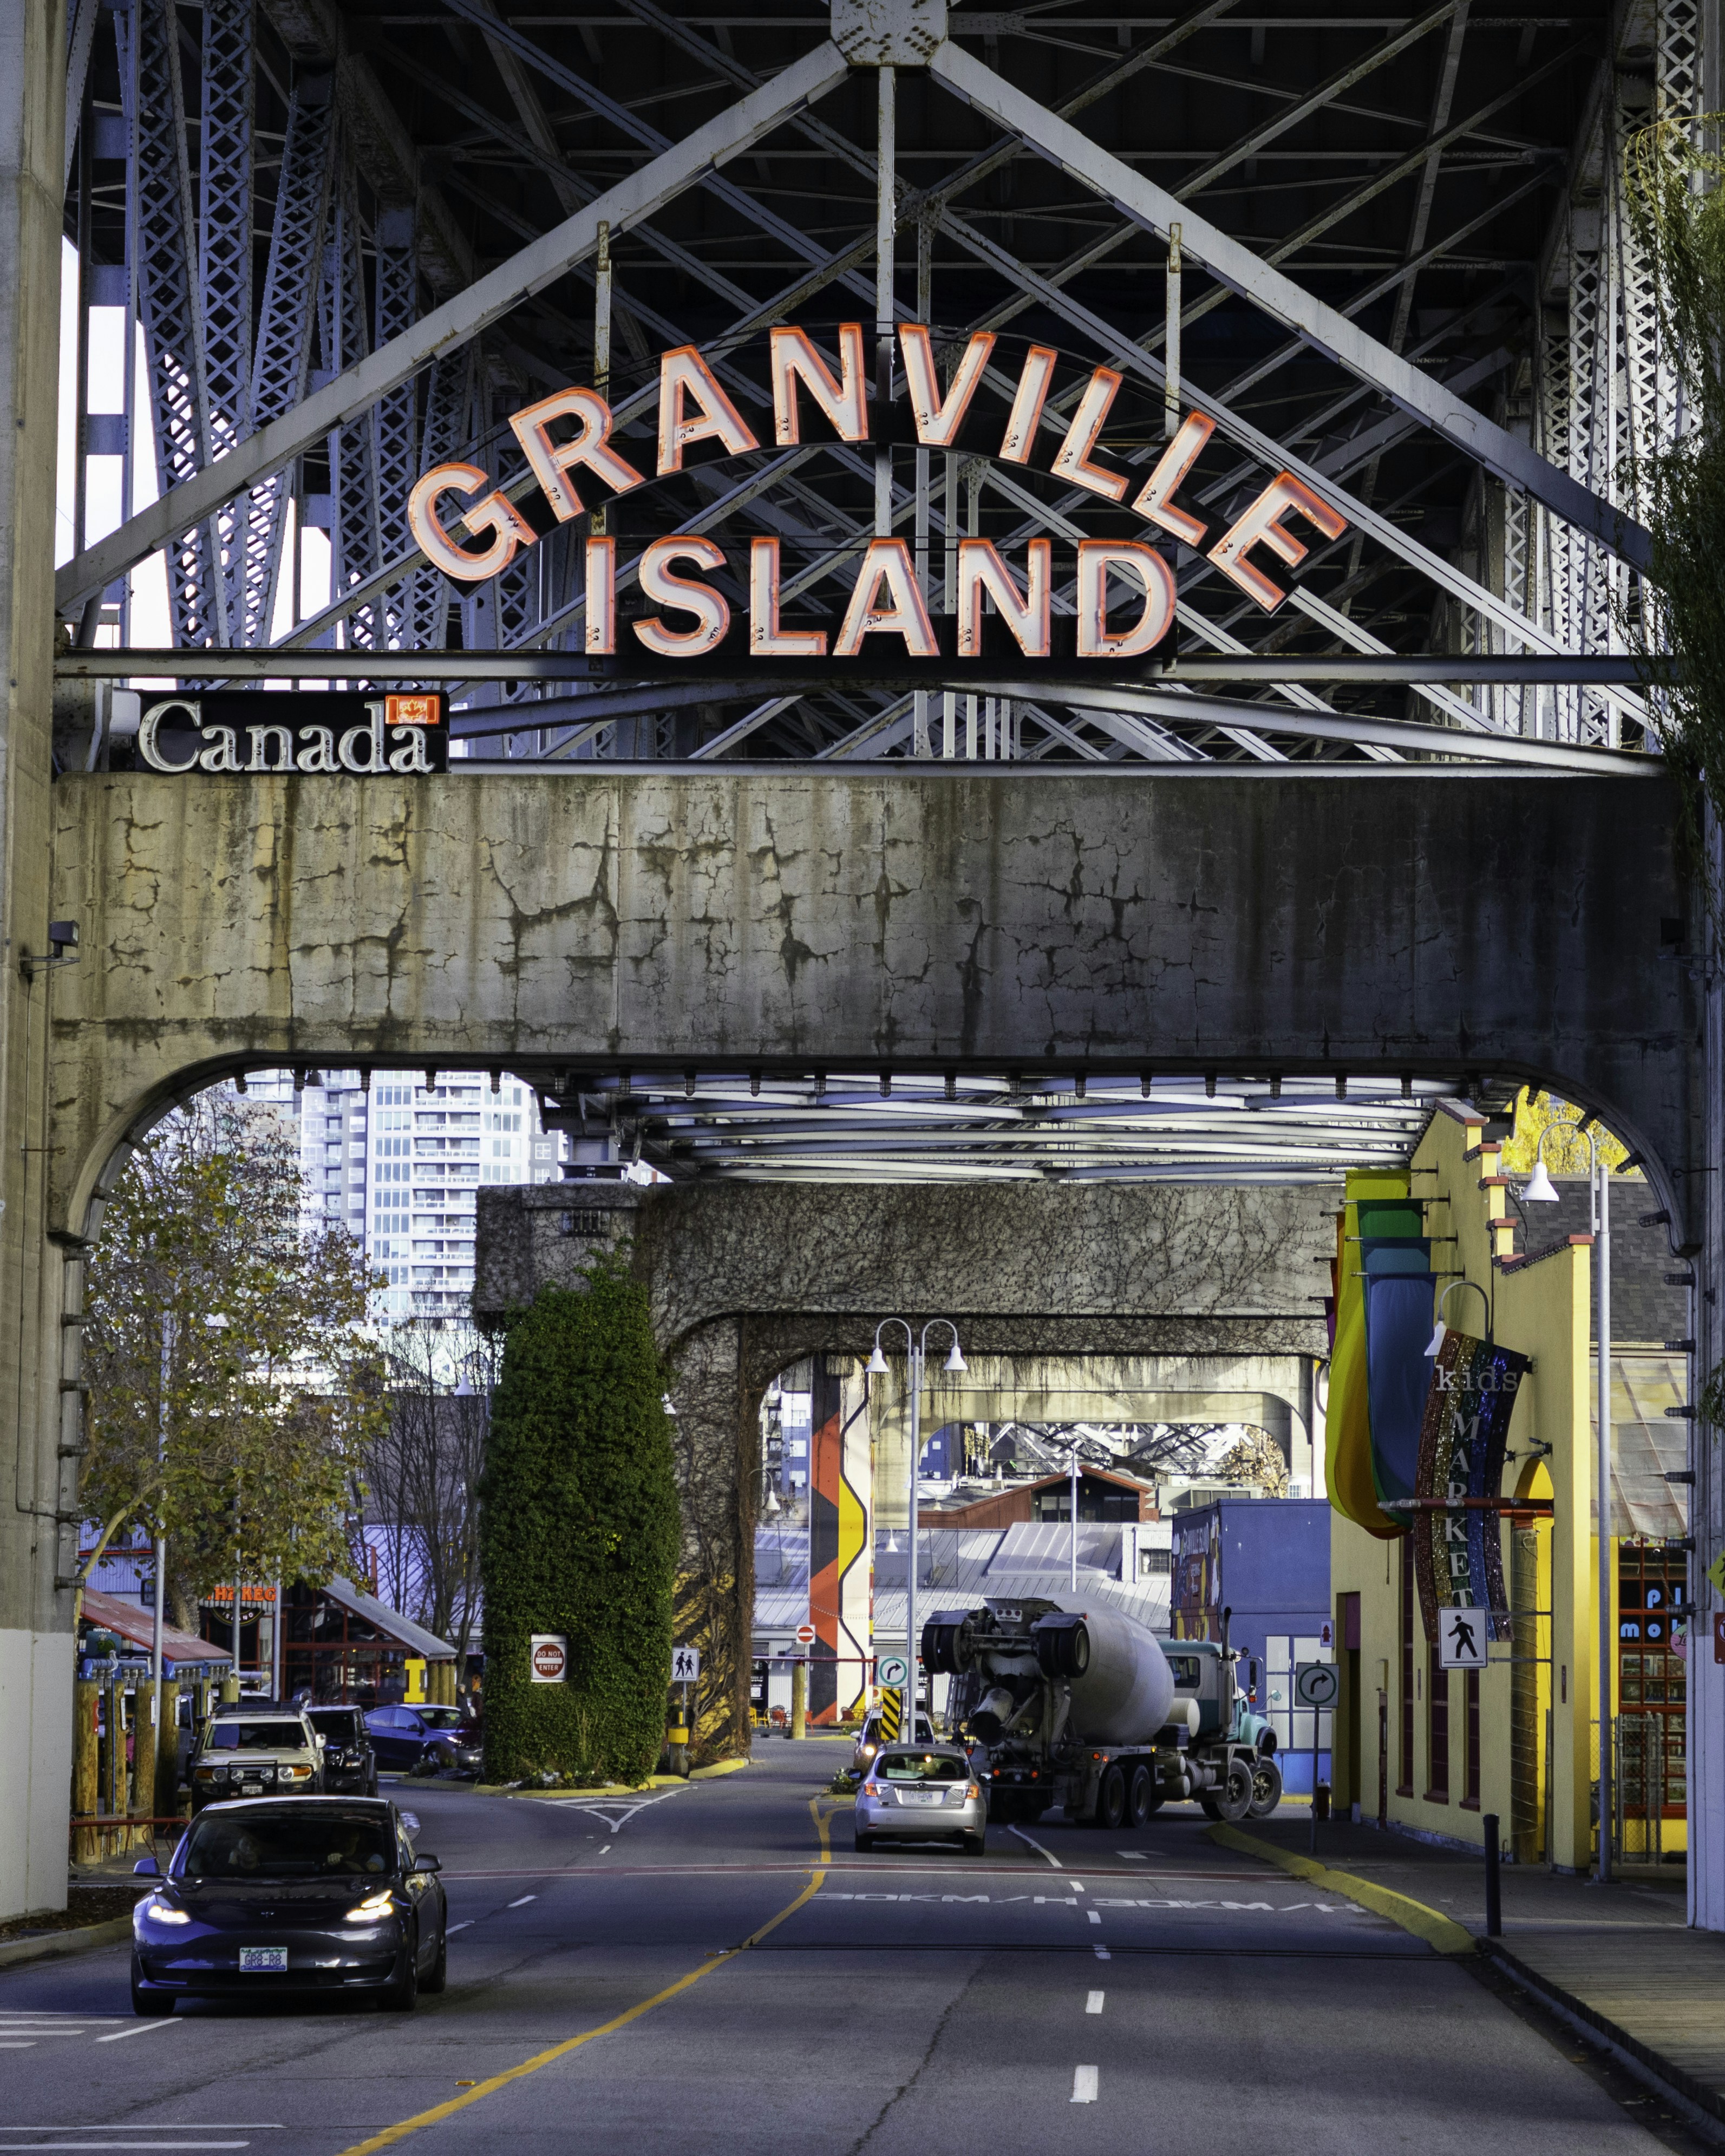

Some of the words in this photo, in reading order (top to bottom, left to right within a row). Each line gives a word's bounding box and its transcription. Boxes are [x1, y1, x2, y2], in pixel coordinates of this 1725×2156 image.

[407, 322, 1348, 613] GRANVILLE
[584, 534, 1177, 658] ISLAND
[139, 700, 436, 773] Canada
[1435, 1365, 1519, 1392] kids
[1445, 1413, 1482, 1608] MARKET
[207, 1586, 234, 1600] HE
[241, 1586, 277, 1602] KEG
[245, 1954, 282, 1965] GR8-R8
